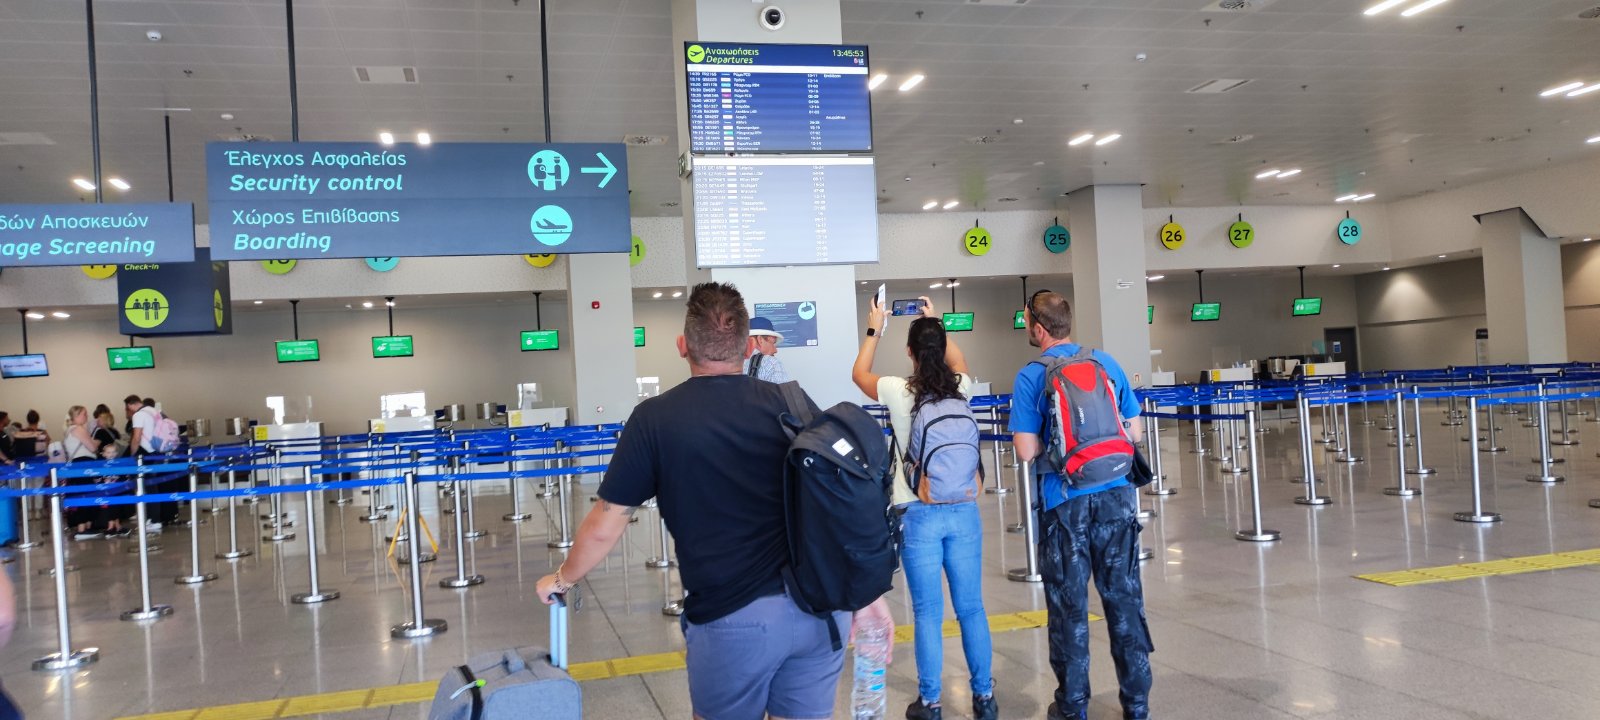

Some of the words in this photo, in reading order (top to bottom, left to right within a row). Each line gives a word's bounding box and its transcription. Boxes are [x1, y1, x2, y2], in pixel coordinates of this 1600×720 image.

[705, 47, 760, 56] Αναχωρήσεις
[706, 56, 753, 64] Departures
[224, 150, 304, 168] Έλεγχος
[311, 150, 406, 168] Ασφαλείας
[230, 174, 320, 194] Security
[328, 174, 403, 190] control
[41, 210, 148, 229] Αποσκευών
[232, 209, 295, 228] Χώρος
[302, 208, 400, 224] Επιβίβασης
[1166, 230, 1182, 242] 26
[1234, 229, 1250, 240] 27
[1342, 226, 1359, 236] 28
[234, 232, 331, 252] Boarding
[969, 236, 988, 248] 24
[1049, 234, 1068, 245] 25
[0, 242, 42, 260] age
[48, 236, 155, 256] Screening
